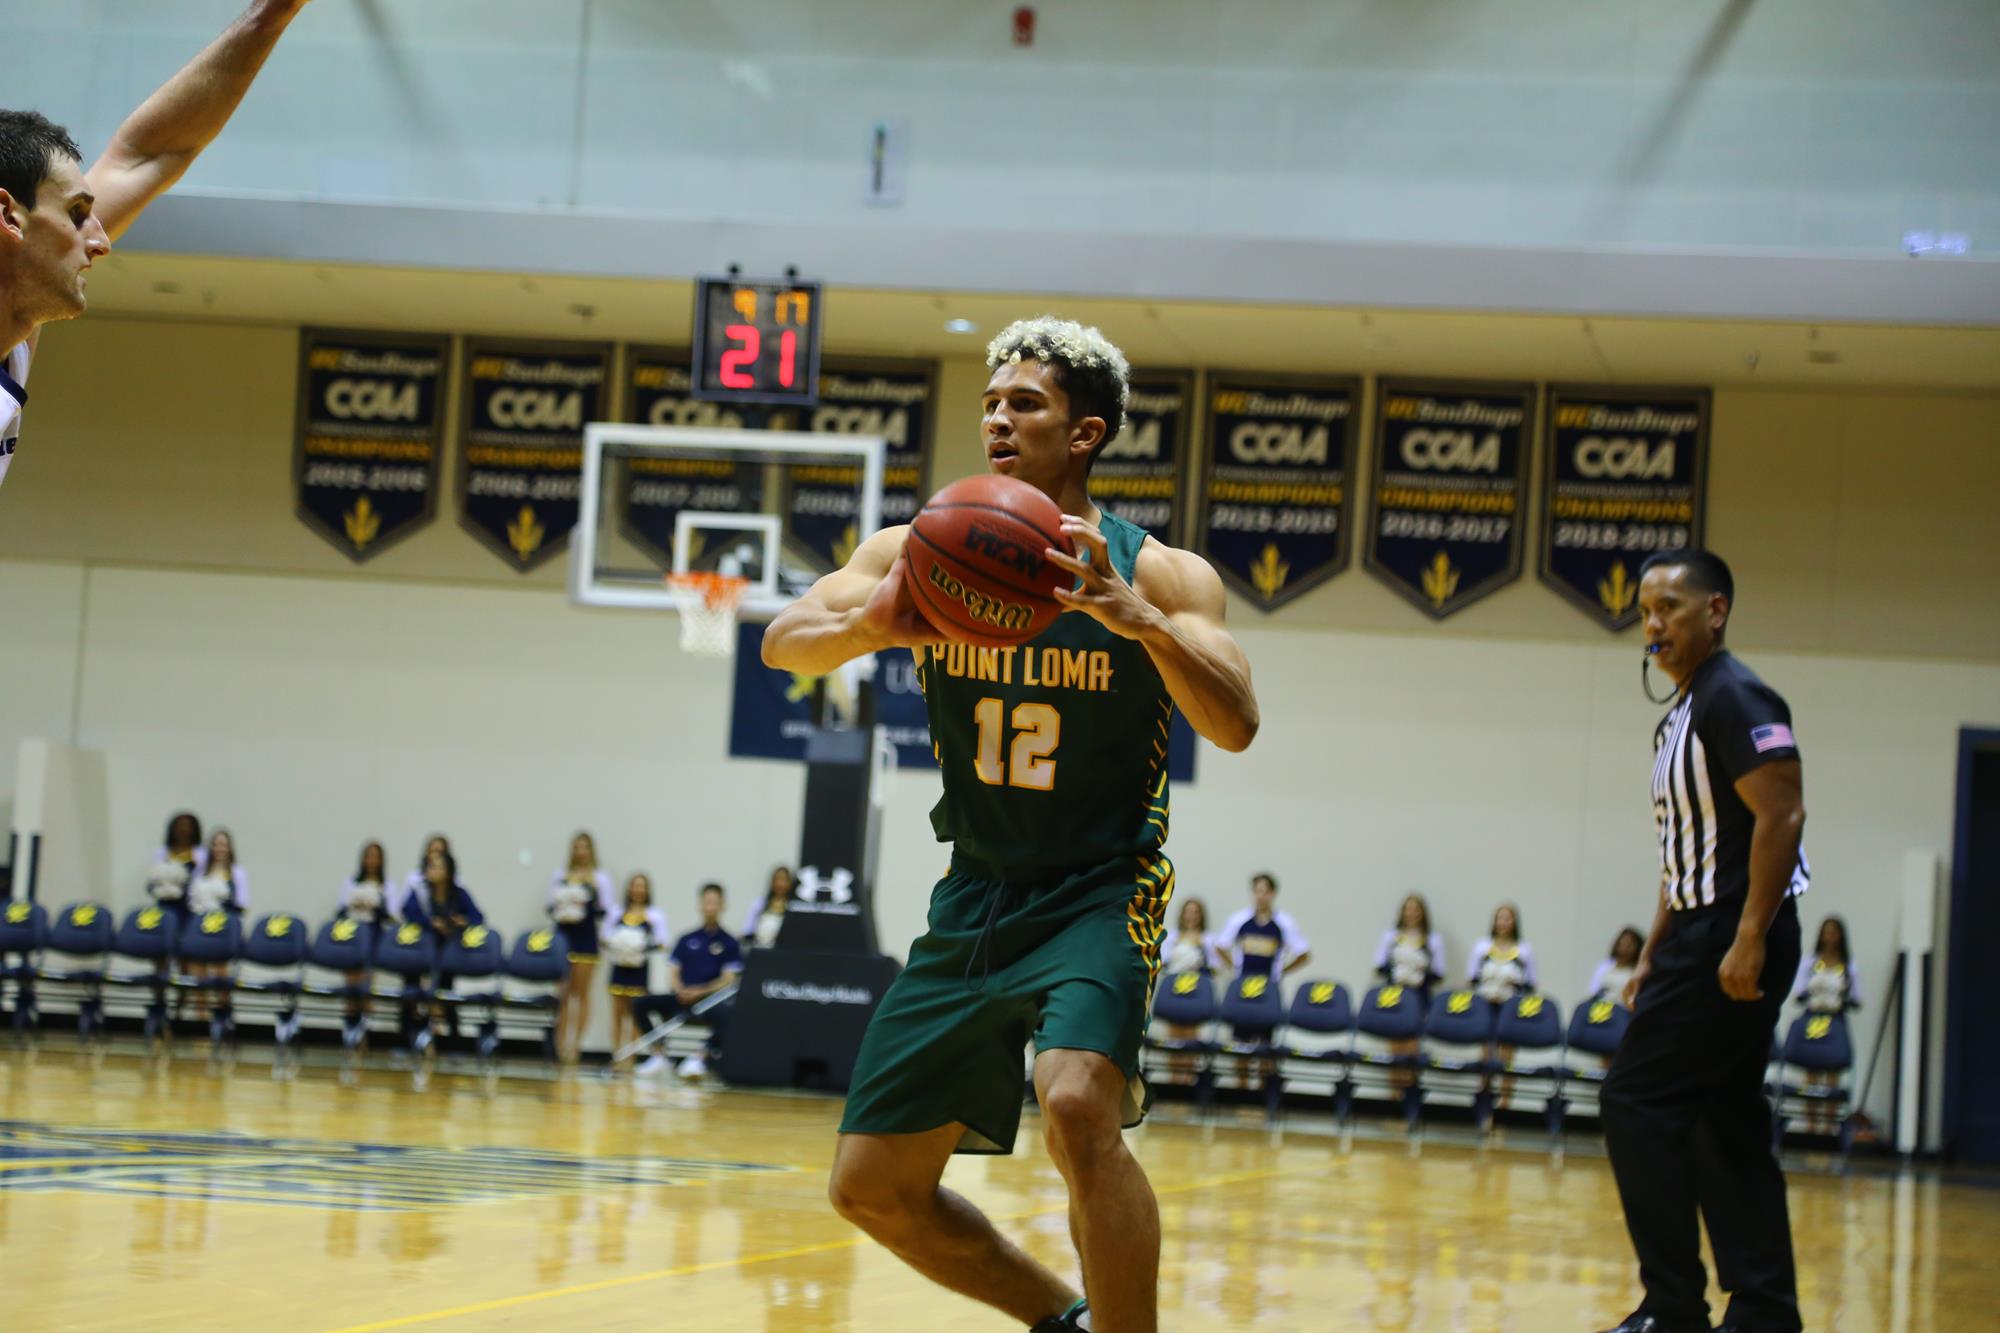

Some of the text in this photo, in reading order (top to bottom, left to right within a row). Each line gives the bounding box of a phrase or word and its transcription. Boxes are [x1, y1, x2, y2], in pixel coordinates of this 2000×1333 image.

[719, 323, 797, 389] 21
[325, 379, 419, 421] CCAA
[488, 388, 583, 430] CCAA
[1229, 422, 1329, 464] CCAA
[1401, 428, 1501, 473] CCAA
[1574, 436, 1677, 479] CCAA
[1209, 480, 1342, 505] CHAMPIONS
[1380, 487, 1515, 513] CHAMPIONS
[1556, 497, 1692, 522] CHAMPIONS
[928, 560, 1035, 630] Wilson
[932, 642, 1115, 692] POINT LOMA
[973, 696, 1061, 791] 12
